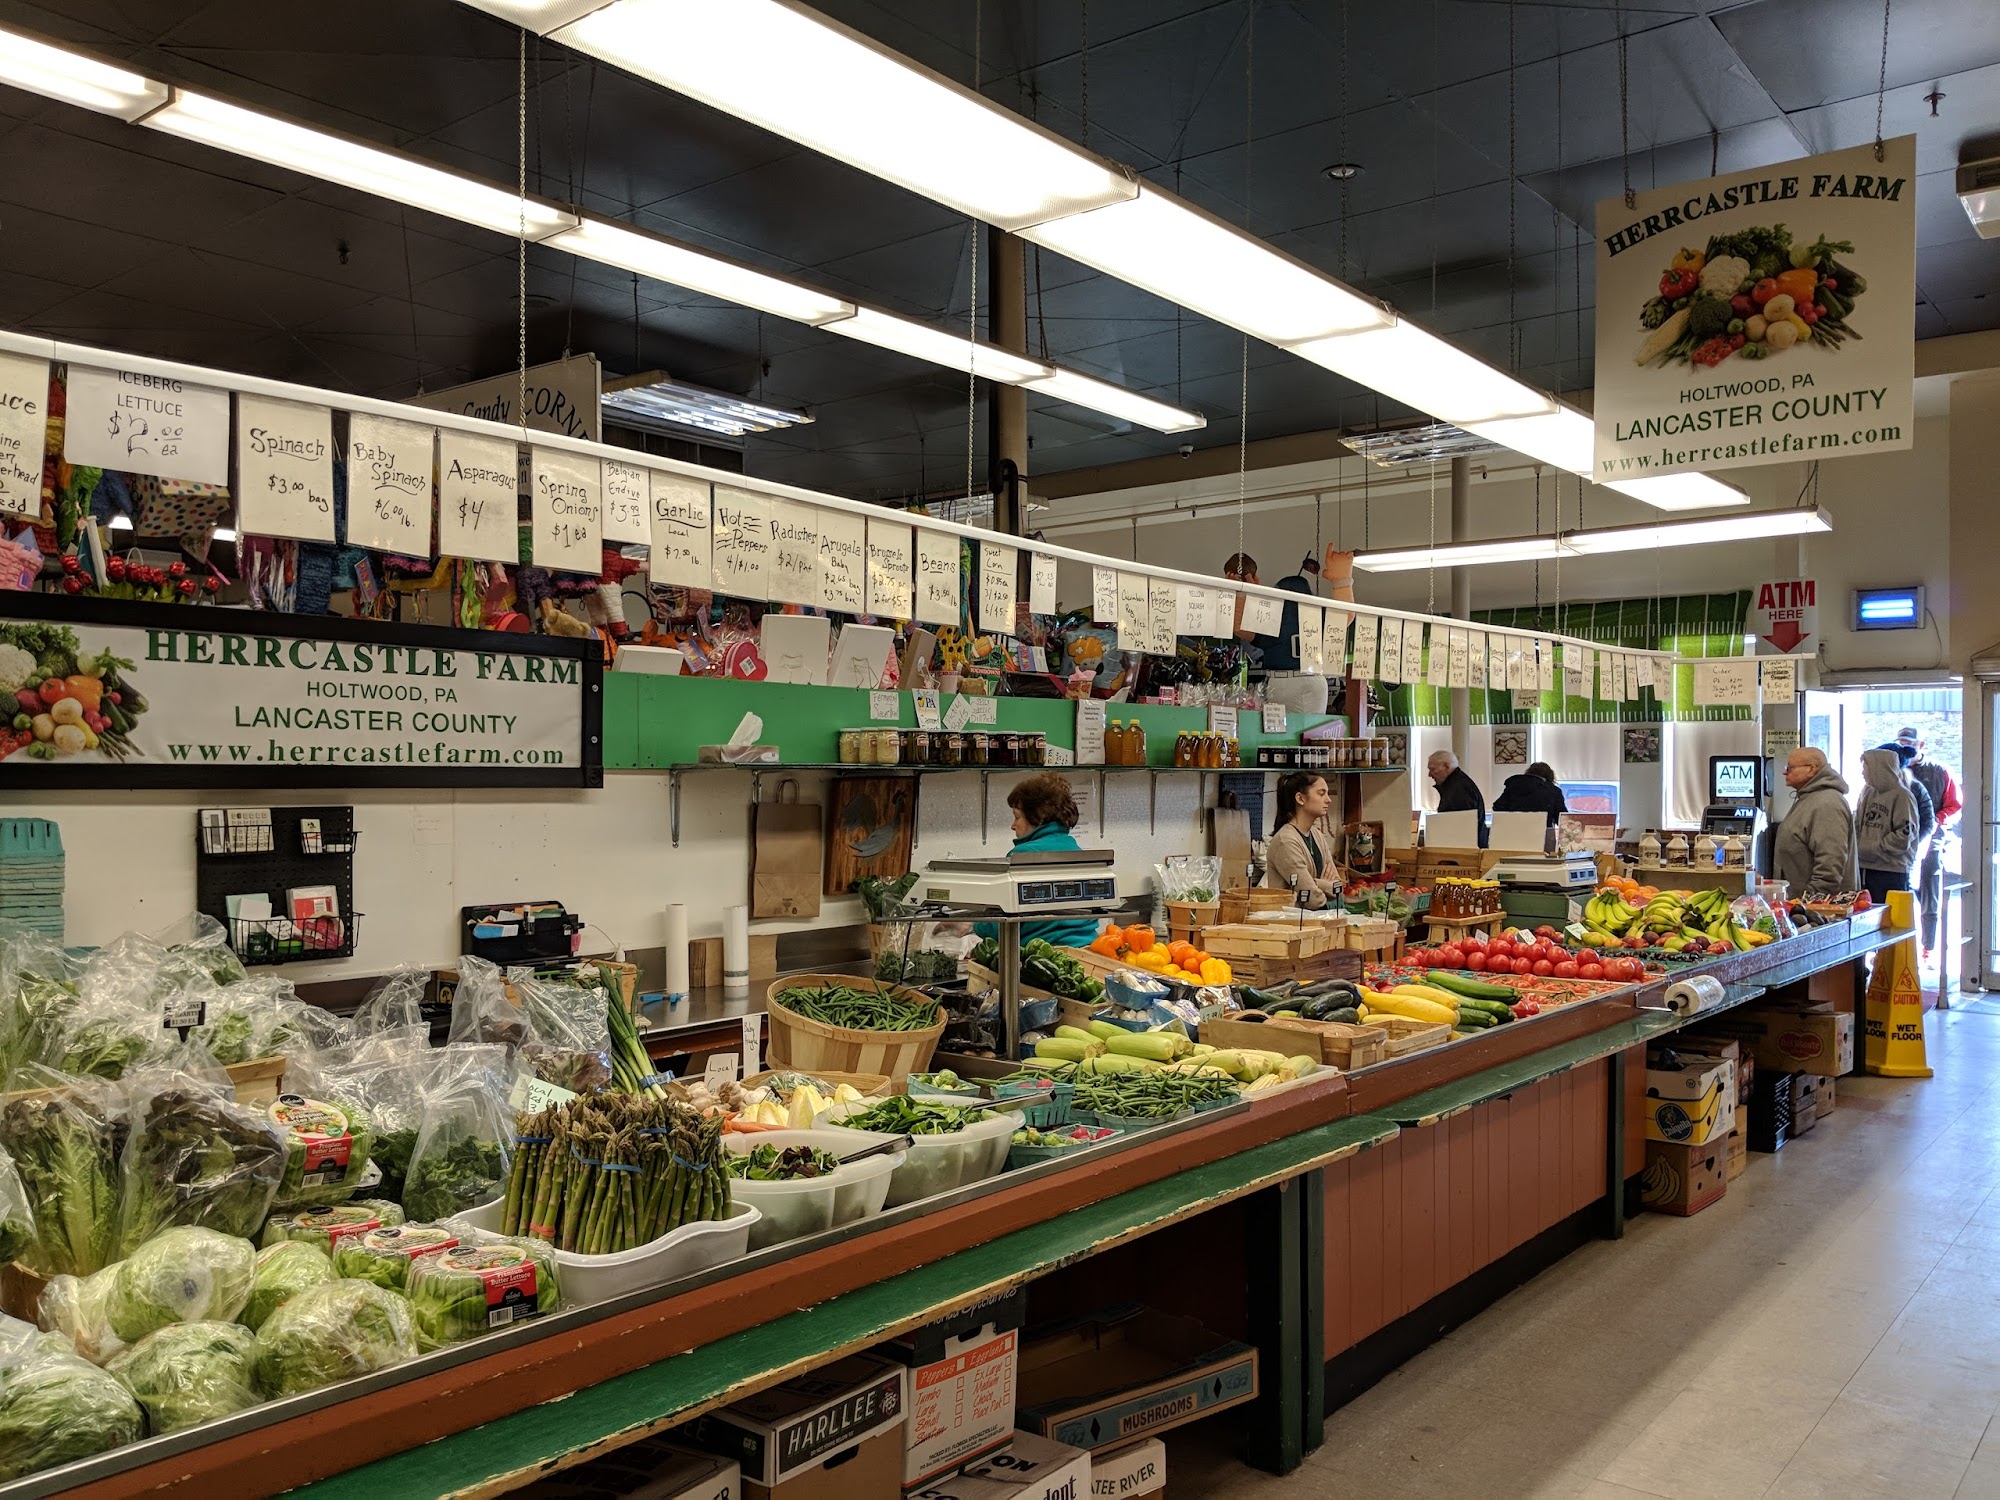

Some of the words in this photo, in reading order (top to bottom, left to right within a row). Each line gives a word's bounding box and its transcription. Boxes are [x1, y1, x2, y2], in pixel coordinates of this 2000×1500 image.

[1603, 176, 1799, 257] HERRCASTLE
[1809, 174, 1906, 202] FARM
[118, 371, 183, 393] ICEBERG
[1680, 377, 1785, 404] HOLTWOOD,
[1791, 373, 1815, 389] PA
[0, 394, 36, 415] uce
[117, 393, 183, 417] LETTUCE
[1615, 403, 1762, 442] LANCASTER
[1771, 387, 1888, 422] COUNTY
[0, 434, 21, 449] ine
[250, 428, 325, 457] Spinach
[1601, 422, 1901, 473] www.herrcastlefarm.com
[354, 442, 396, 468] Baby
[0, 463, 39, 485] erhead
[371, 463, 426, 491] Spinach
[446, 459, 517, 490] Asparagus
[607, 462, 641, 483] Belgian
[268, 474, 304, 494] $3.00
[539, 475, 587, 503] Spring
[608, 484, 640, 499] Endive
[308, 489, 329, 512] bag
[552, 497, 598, 522] Onions
[656, 498, 704, 521] Garlic
[458, 497, 485, 530] $4
[719, 507, 742, 528] Hot
[551, 524, 571, 547] $1
[575, 527, 587, 540] ea
[668, 524, 689, 537] Local
[731, 529, 768, 553] Peppers
[770, 520, 817, 545] Radishes
[820, 535, 861, 557] Arugala
[870, 544, 903, 561] Brussels
[984, 547, 1001, 557] Sweet
[921, 553, 956, 572] Beans
[986, 558, 1003, 569] Corn
[1151, 591, 1176, 608] Peppers
[1757, 580, 1816, 610] ATM
[1768, 609, 1804, 620] HERE
[145, 629, 457, 678] HERRCASTLE
[475, 652, 579, 685] FARM
[1712, 666, 1732, 674] Cider
[306, 681, 428, 704] HOLTWOOD,
[435, 687, 458, 703] PA
[235, 705, 403, 731] LANCASTER
[412, 711, 517, 734] COUNTY
[167, 739, 564, 765] www.herrcastlefarm.com
[1719, 765, 1752, 779] ATM
[1734, 808, 1754, 817] ATM
[1893, 994, 1920, 1005] CAUTION
[1891, 1032, 1922, 1041] FLOOR
[1896, 1024, 1917, 1032] WET
[709, 1058, 733, 1072] Local
[529, 1083, 553, 1098] ocal
[1663, 1119, 1692, 1137] Chiquita
[490, 1276, 509, 1286] Butter
[510, 1272, 531, 1281] Lettuce
[496, 1269, 523, 1278] Premium
[920, 1363, 956, 1384] Peppers
[969, 1341, 1004, 1366] Eggplant
[974, 1369, 985, 1383] Ex
[985, 1362, 1003, 1376] Large
[972, 1376, 999, 1395] Medium
[915, 1387, 941, 1406] Jumbo
[973, 1390, 994, 1407] Choice
[916, 1402, 937, 1418] Large
[972, 1405, 989, 1421] Place
[1122, 1396, 1193, 1432] MUSHROOMS
[787, 1390, 876, 1456] HARLLEE
[915, 1411, 941, 1432] Small
[928, 1449, 945, 1460] PACKED
[951, 1438, 968, 1450] FLORIDA
[1119, 1462, 1157, 1493] RIVER
